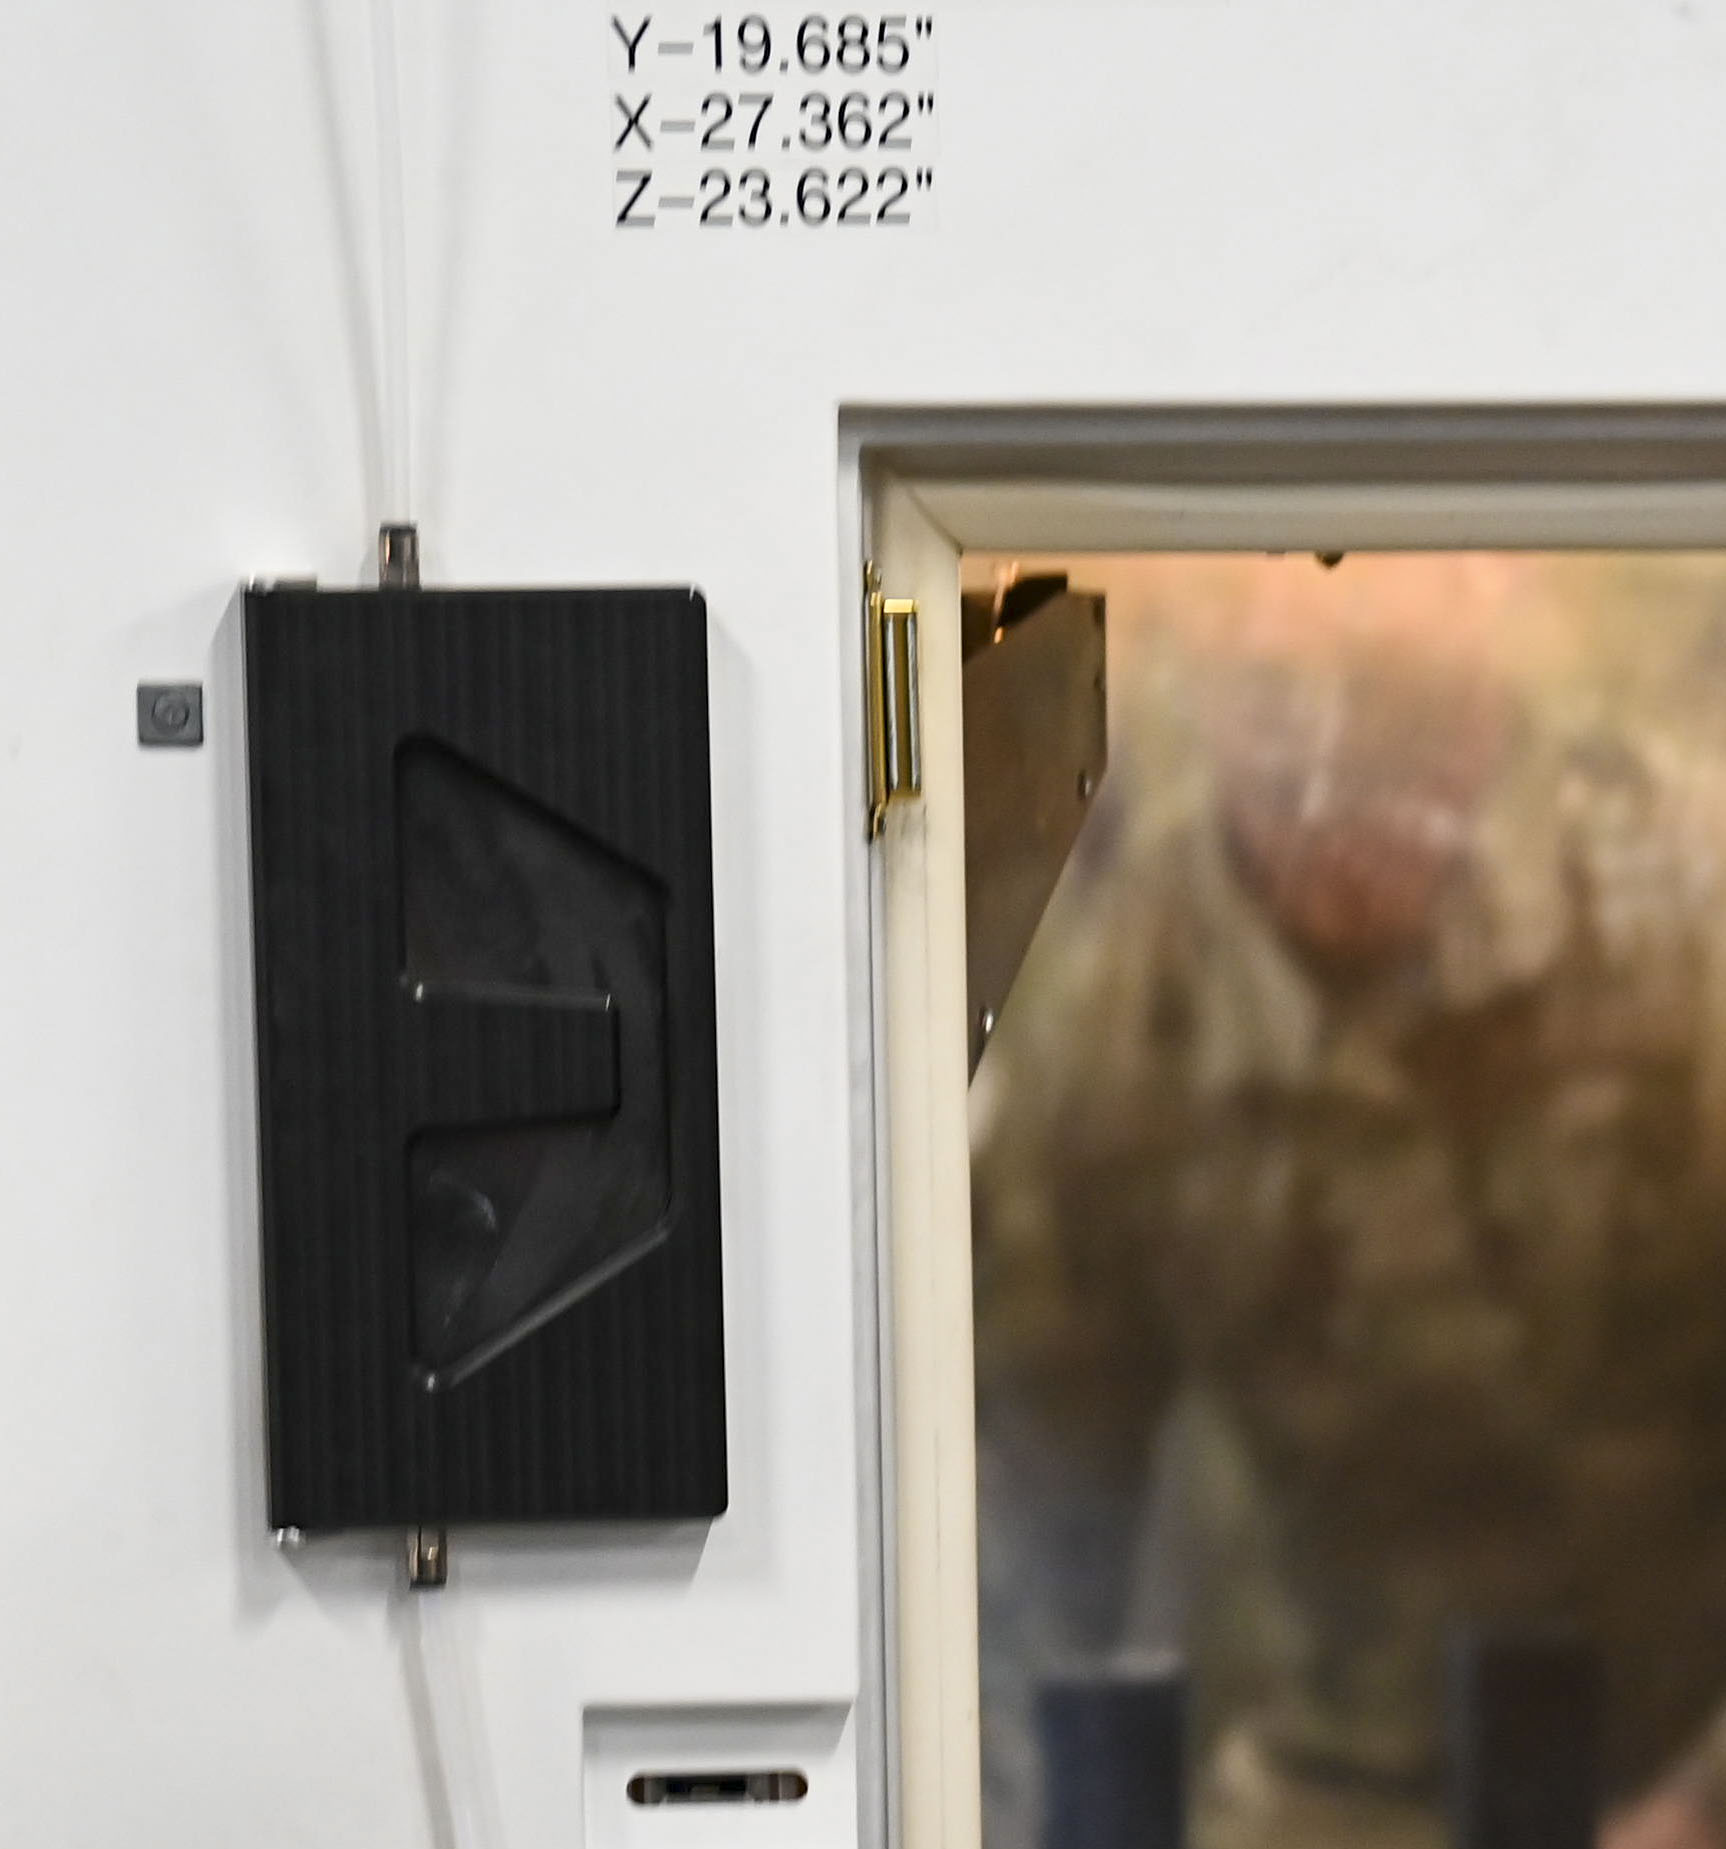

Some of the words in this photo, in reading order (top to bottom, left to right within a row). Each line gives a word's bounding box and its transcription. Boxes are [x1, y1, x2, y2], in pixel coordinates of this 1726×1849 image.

[610, 13, 933, 76] Y-19.685"
[613, 90, 935, 153] X-27.362"
[614, 166, 934, 228] Z-23.622"
